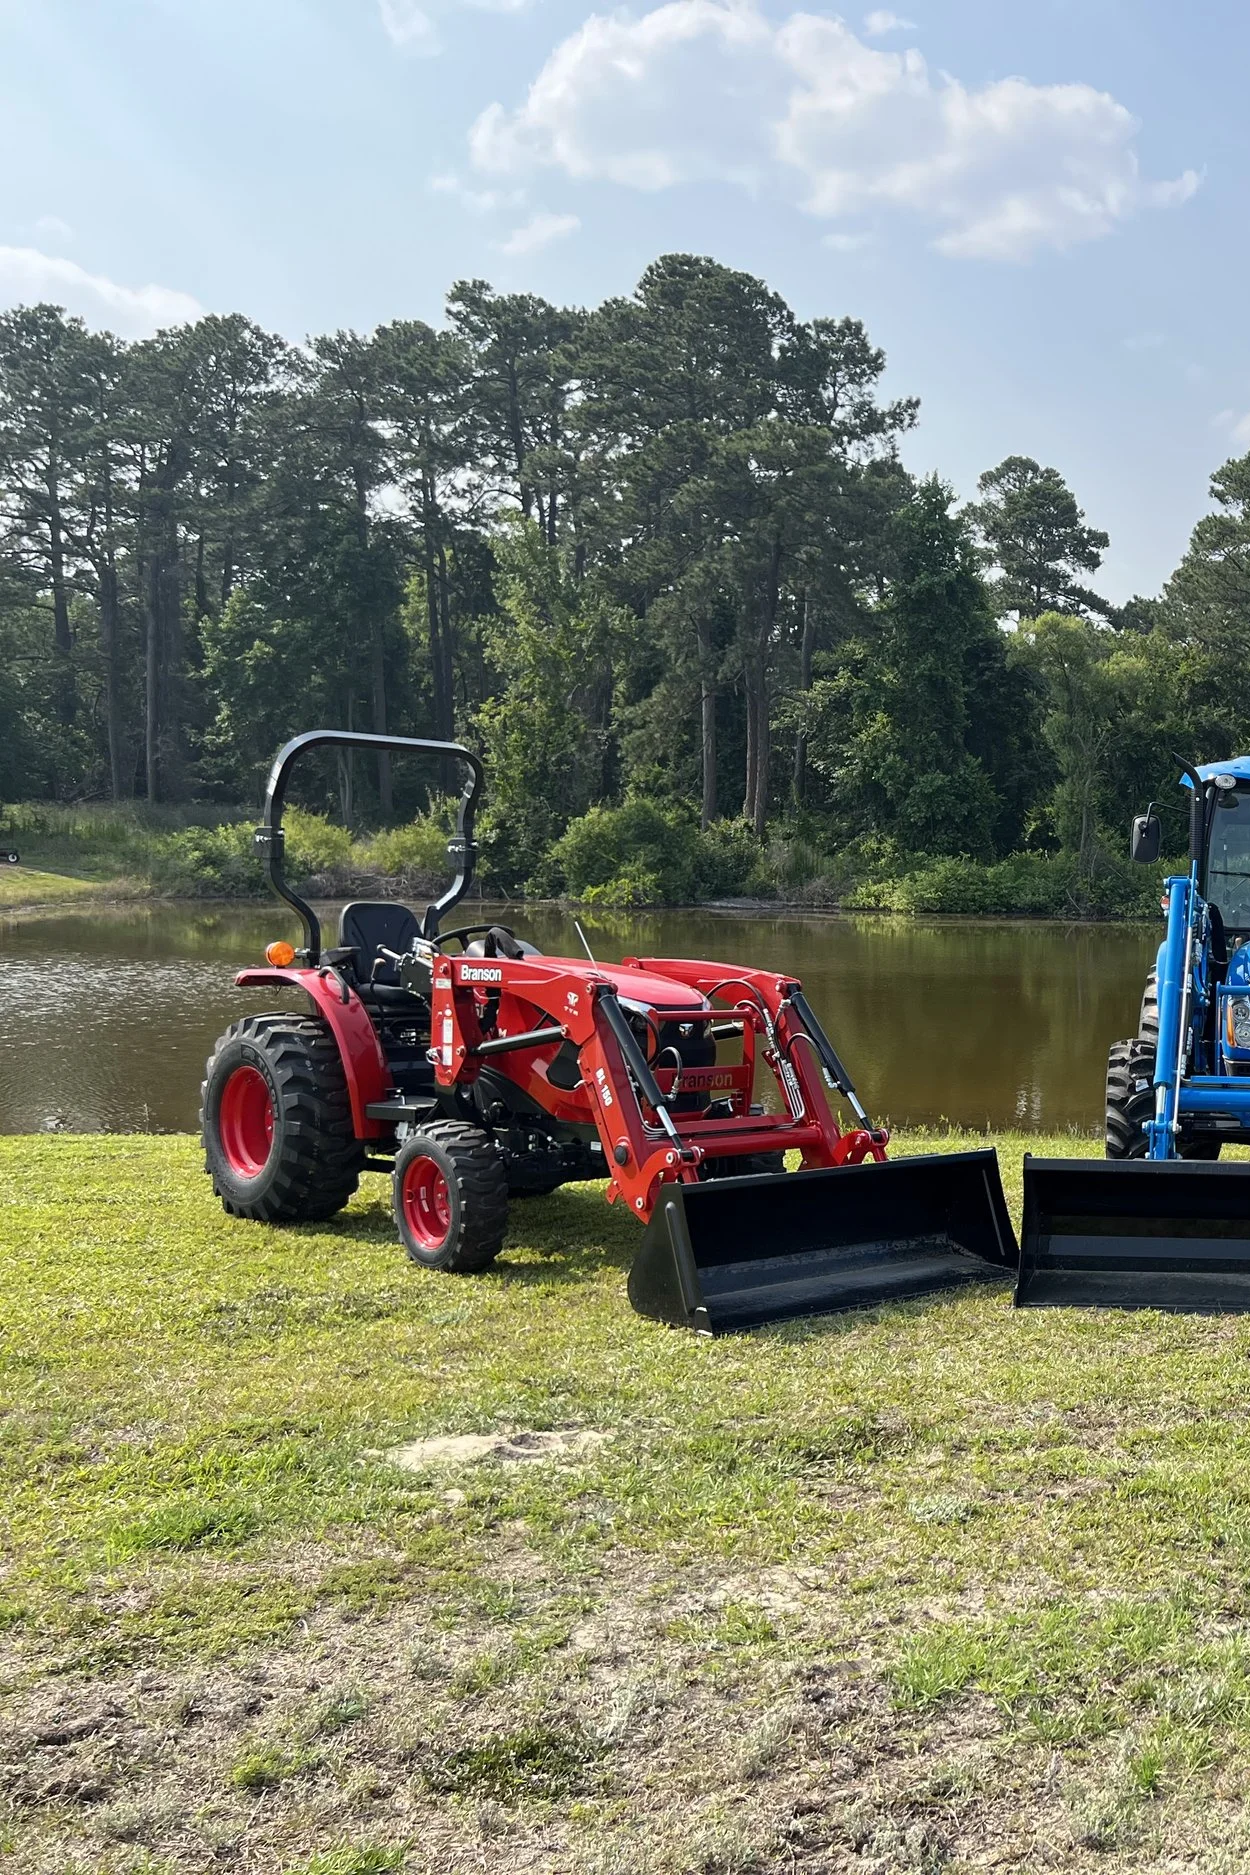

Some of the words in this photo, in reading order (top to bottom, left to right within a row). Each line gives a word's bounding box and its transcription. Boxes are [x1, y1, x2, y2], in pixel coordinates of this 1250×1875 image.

[461, 964, 502, 981] Branson
[595, 1067, 606, 1085] BL
[601, 1084, 613, 1107] 150
